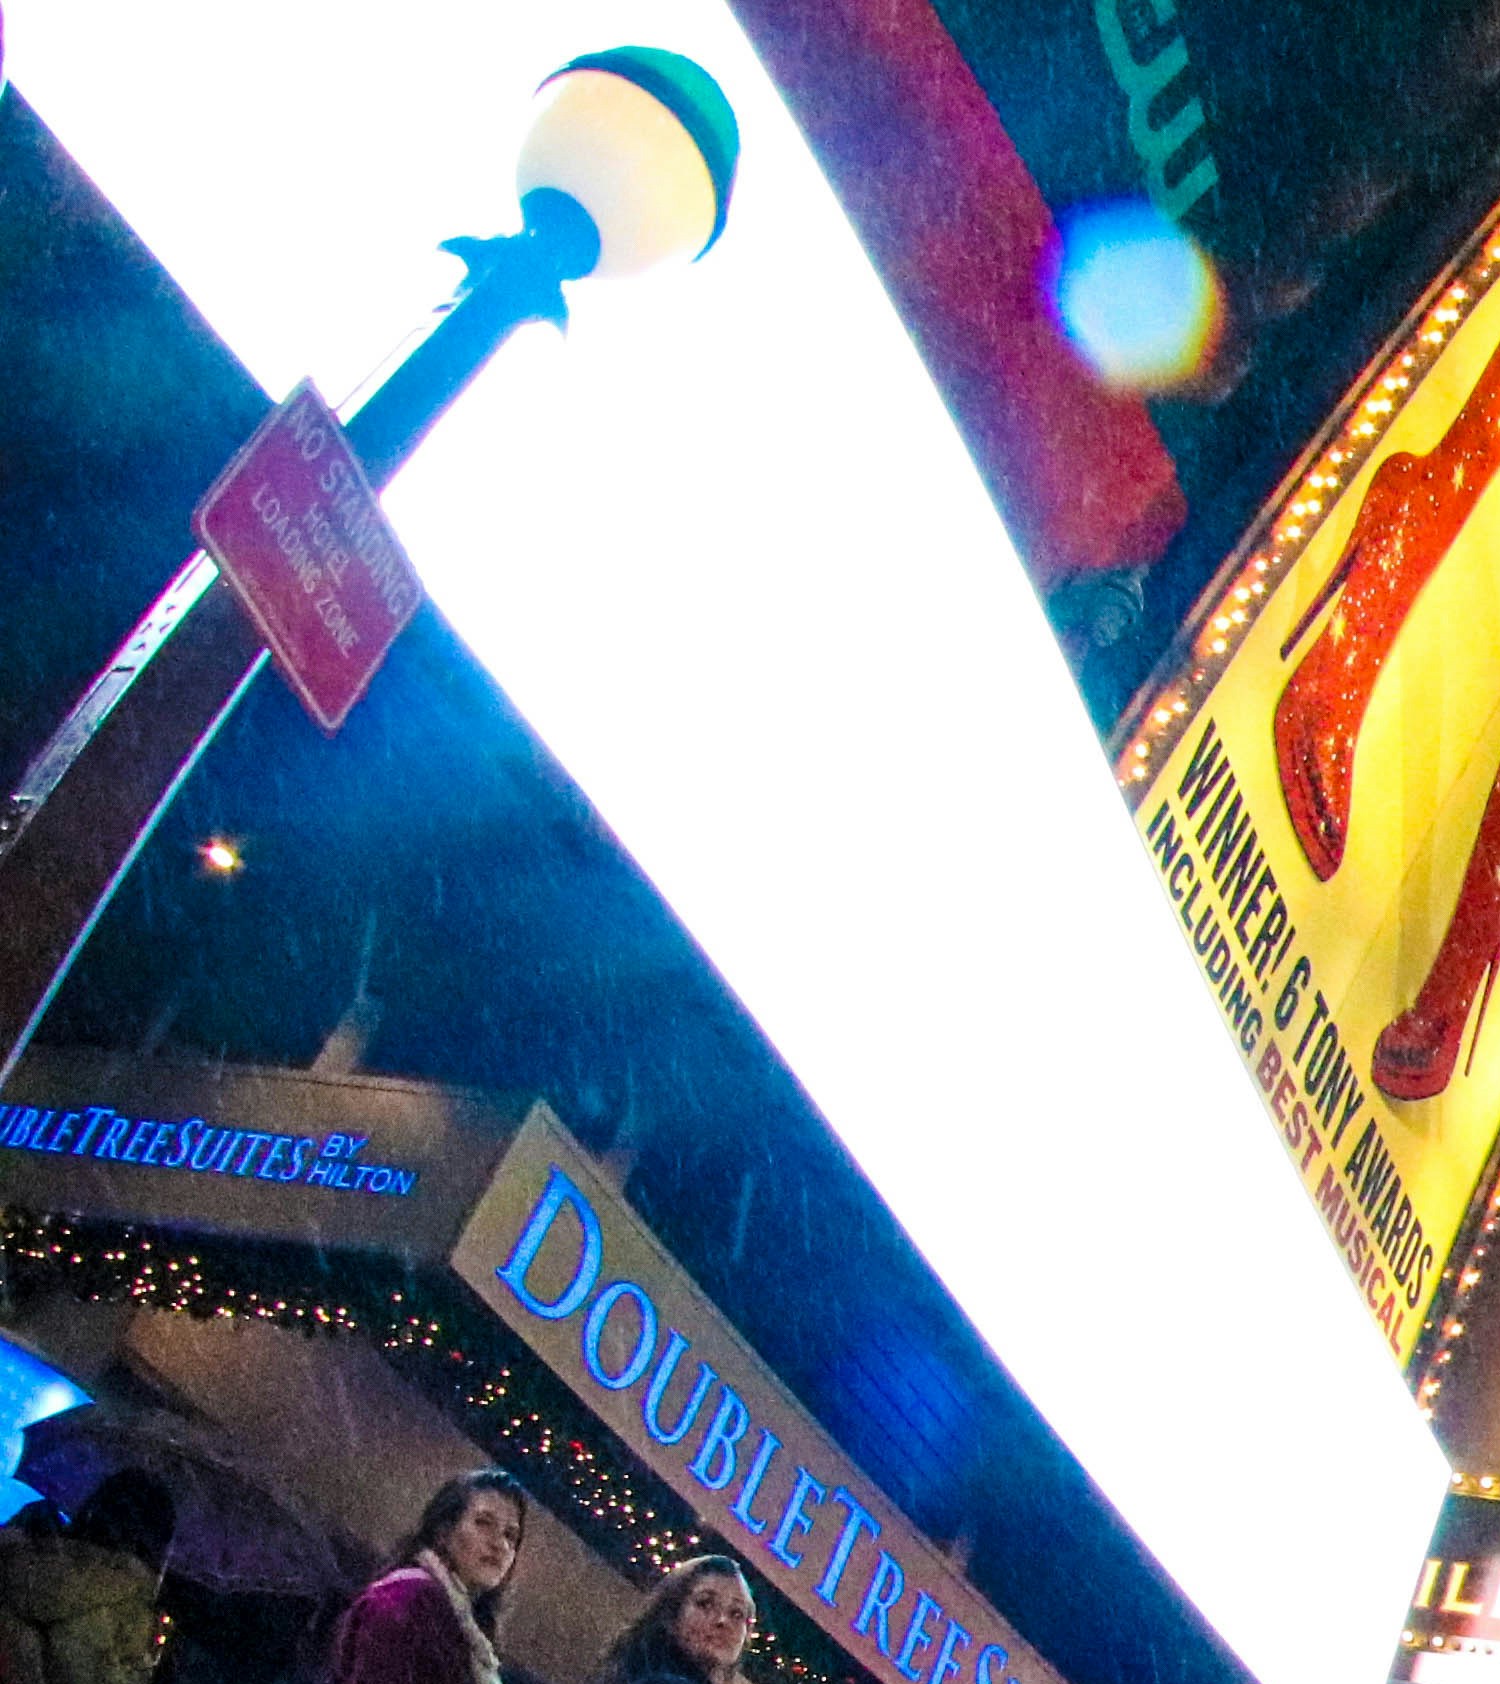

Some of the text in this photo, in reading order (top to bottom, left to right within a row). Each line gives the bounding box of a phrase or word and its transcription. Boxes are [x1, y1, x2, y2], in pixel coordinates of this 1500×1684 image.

[252, 482, 322, 594] LOADING
[320, 460, 409, 616] STANDING
[1145, 799, 1405, 1353] INCLUDING BEST MUSICAL
[1176, 716, 1436, 1313] WINNER! 6 TONY AWARDS
[308, 1160, 417, 1195] HILTON
[319, 1133, 368, 1160] BY
